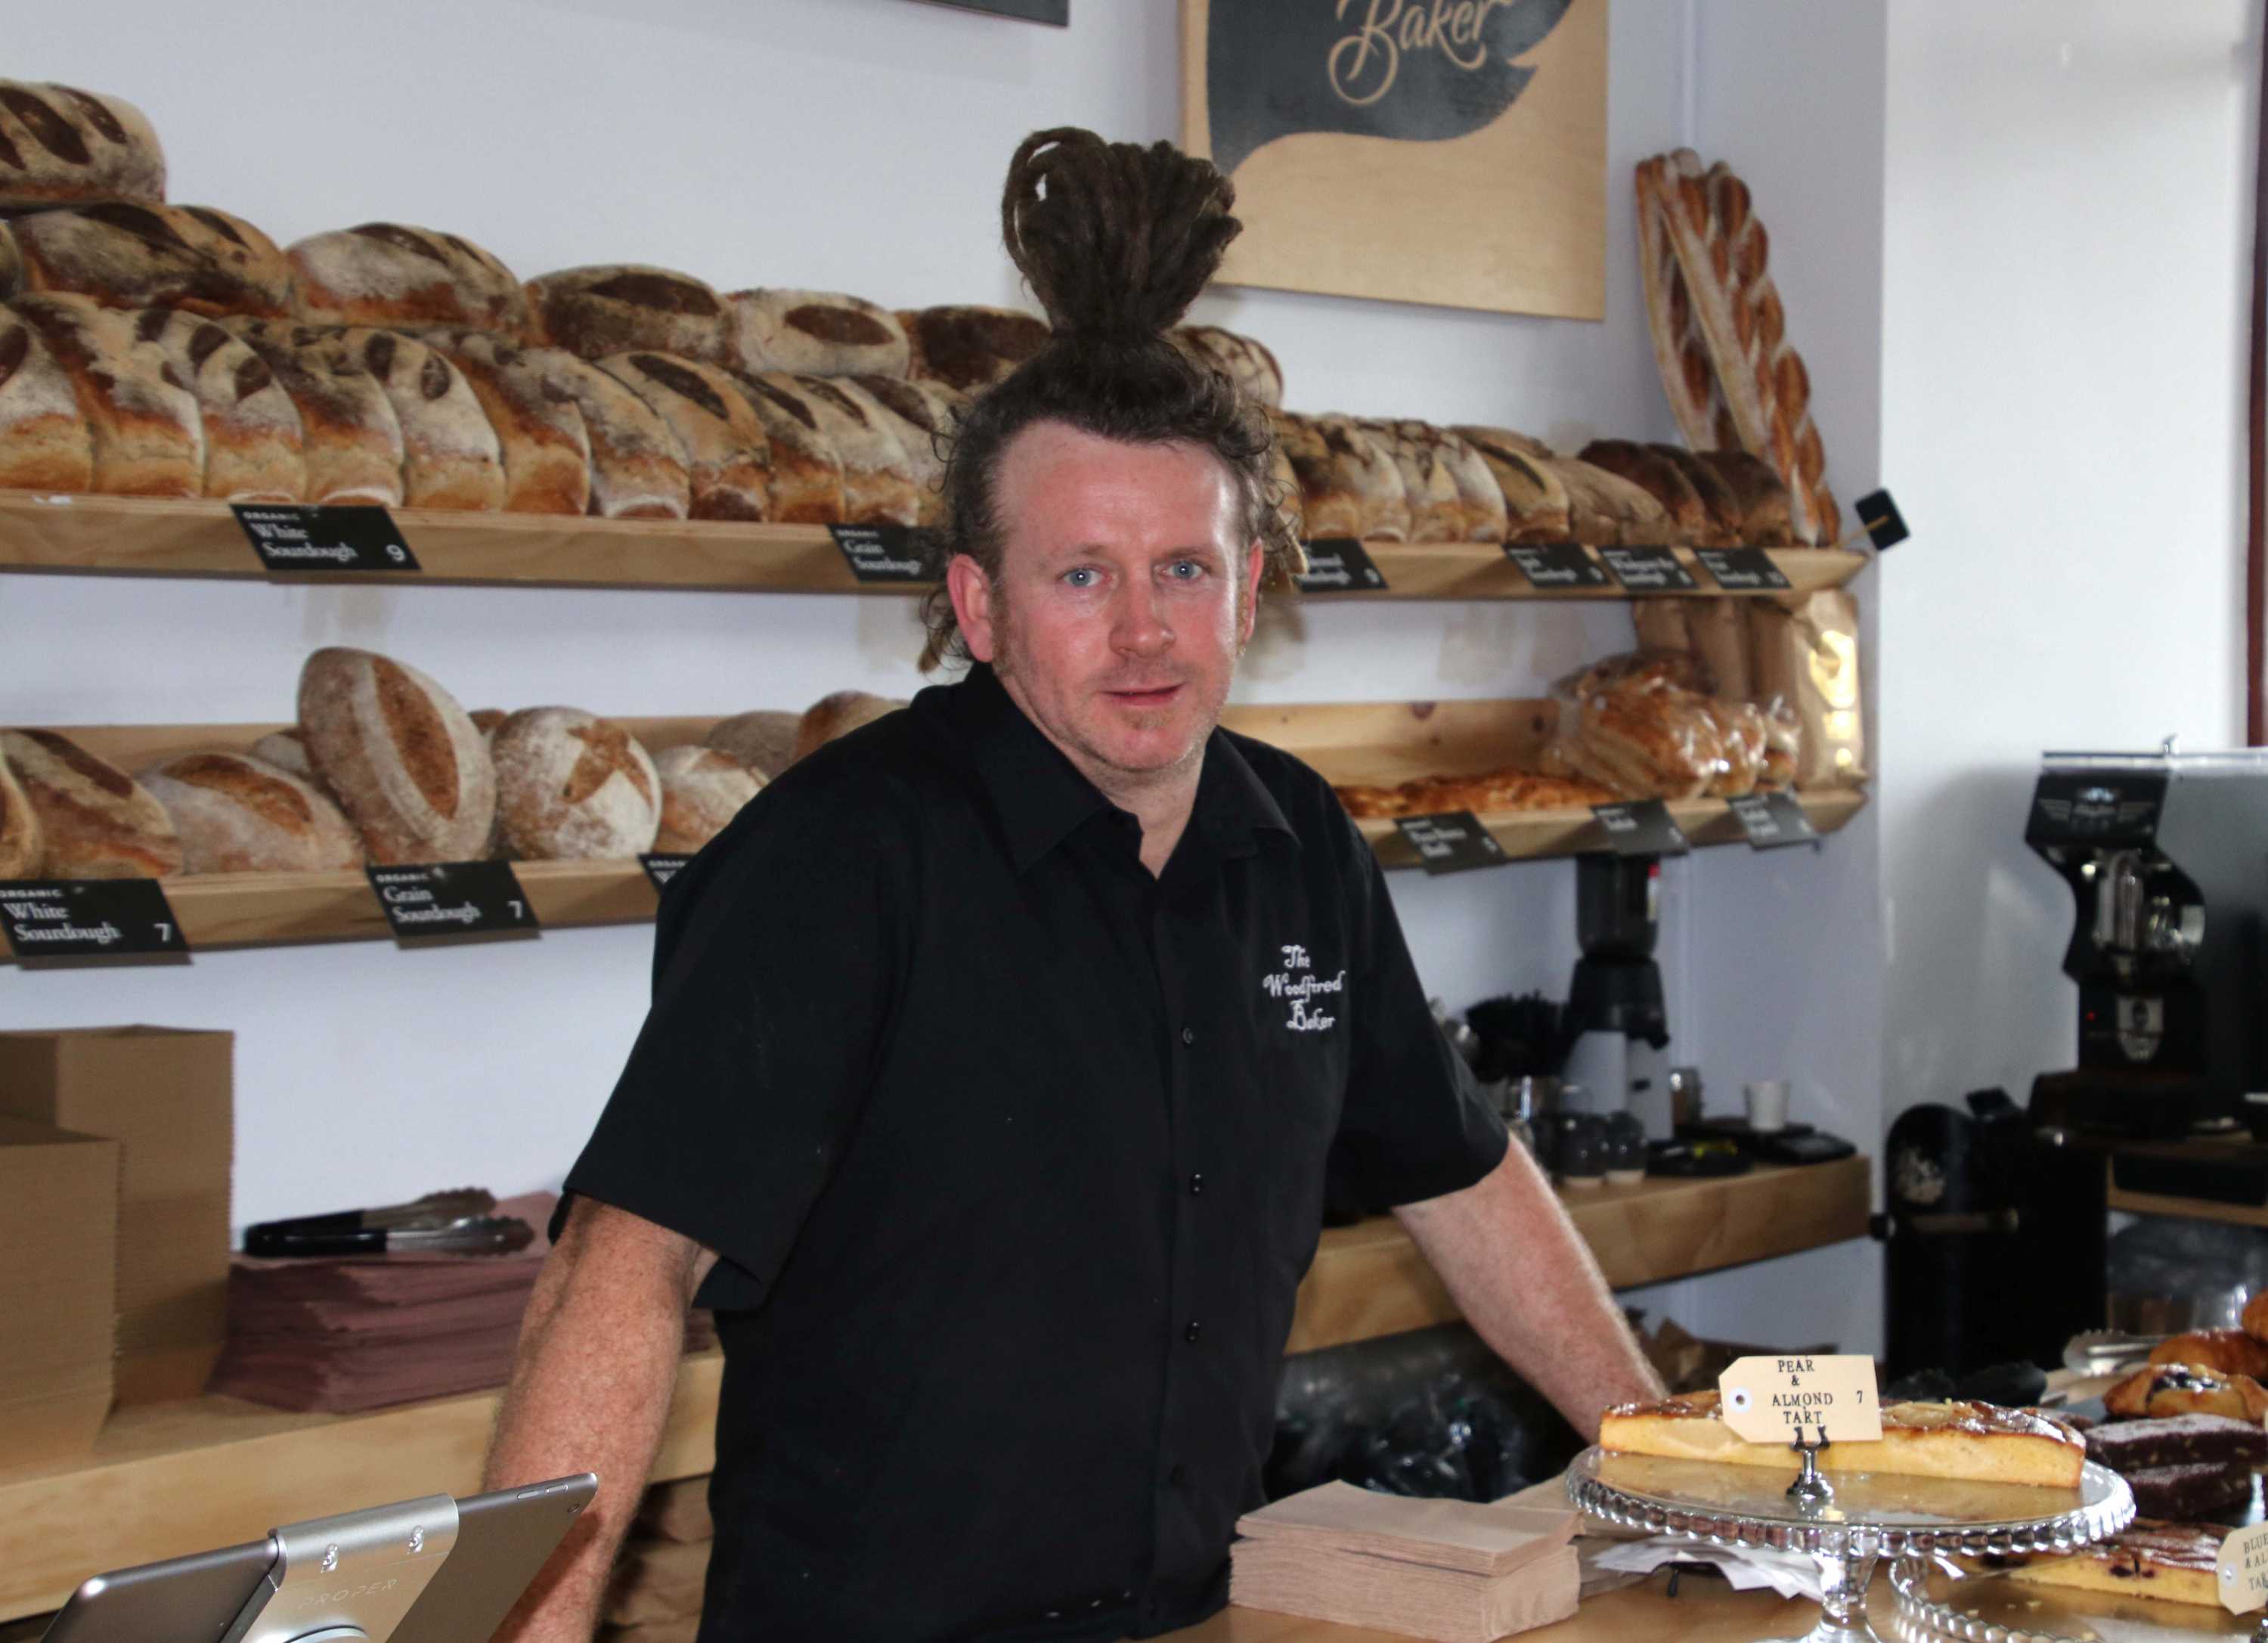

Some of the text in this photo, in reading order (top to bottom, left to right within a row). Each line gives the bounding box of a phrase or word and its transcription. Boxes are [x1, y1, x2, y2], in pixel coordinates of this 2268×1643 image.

[1328, 0, 1514, 107] Baker
[386, 544, 406, 562] 9
[2, 901, 69, 919] White
[507, 900, 523, 919] 7
[14, 921, 172, 944] Sourdough 7
[1281, 944, 1311, 969] The
[1777, 1359, 1815, 1374] PEAR
[1790, 1374, 1800, 1387] &
[1771, 1390, 1864, 1407] ALMOND 7
[1783, 1409, 1823, 1424] TART
